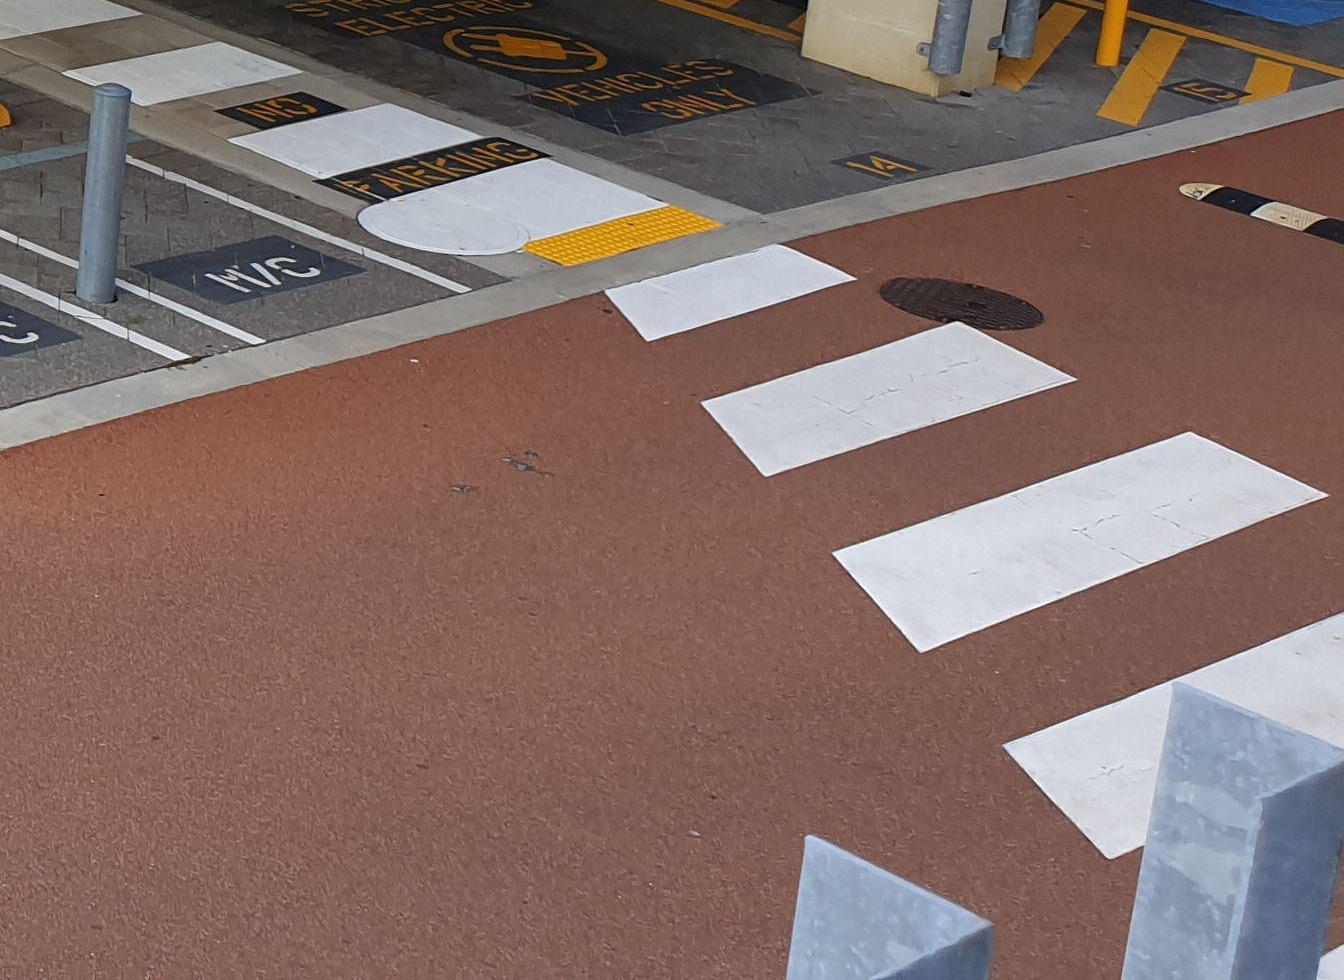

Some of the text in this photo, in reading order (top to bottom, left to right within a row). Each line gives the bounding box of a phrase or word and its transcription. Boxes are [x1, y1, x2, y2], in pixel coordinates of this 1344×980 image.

[531, 61, 735, 106] VEHICLES
[1172, 81, 1240, 102] 15
[236, 95, 318, 123] NO
[641, 88, 757, 120] ONLY
[334, 140, 541, 199] PARKING
[846, 155, 919, 179] 14
[204, 255, 322, 293] M/C
